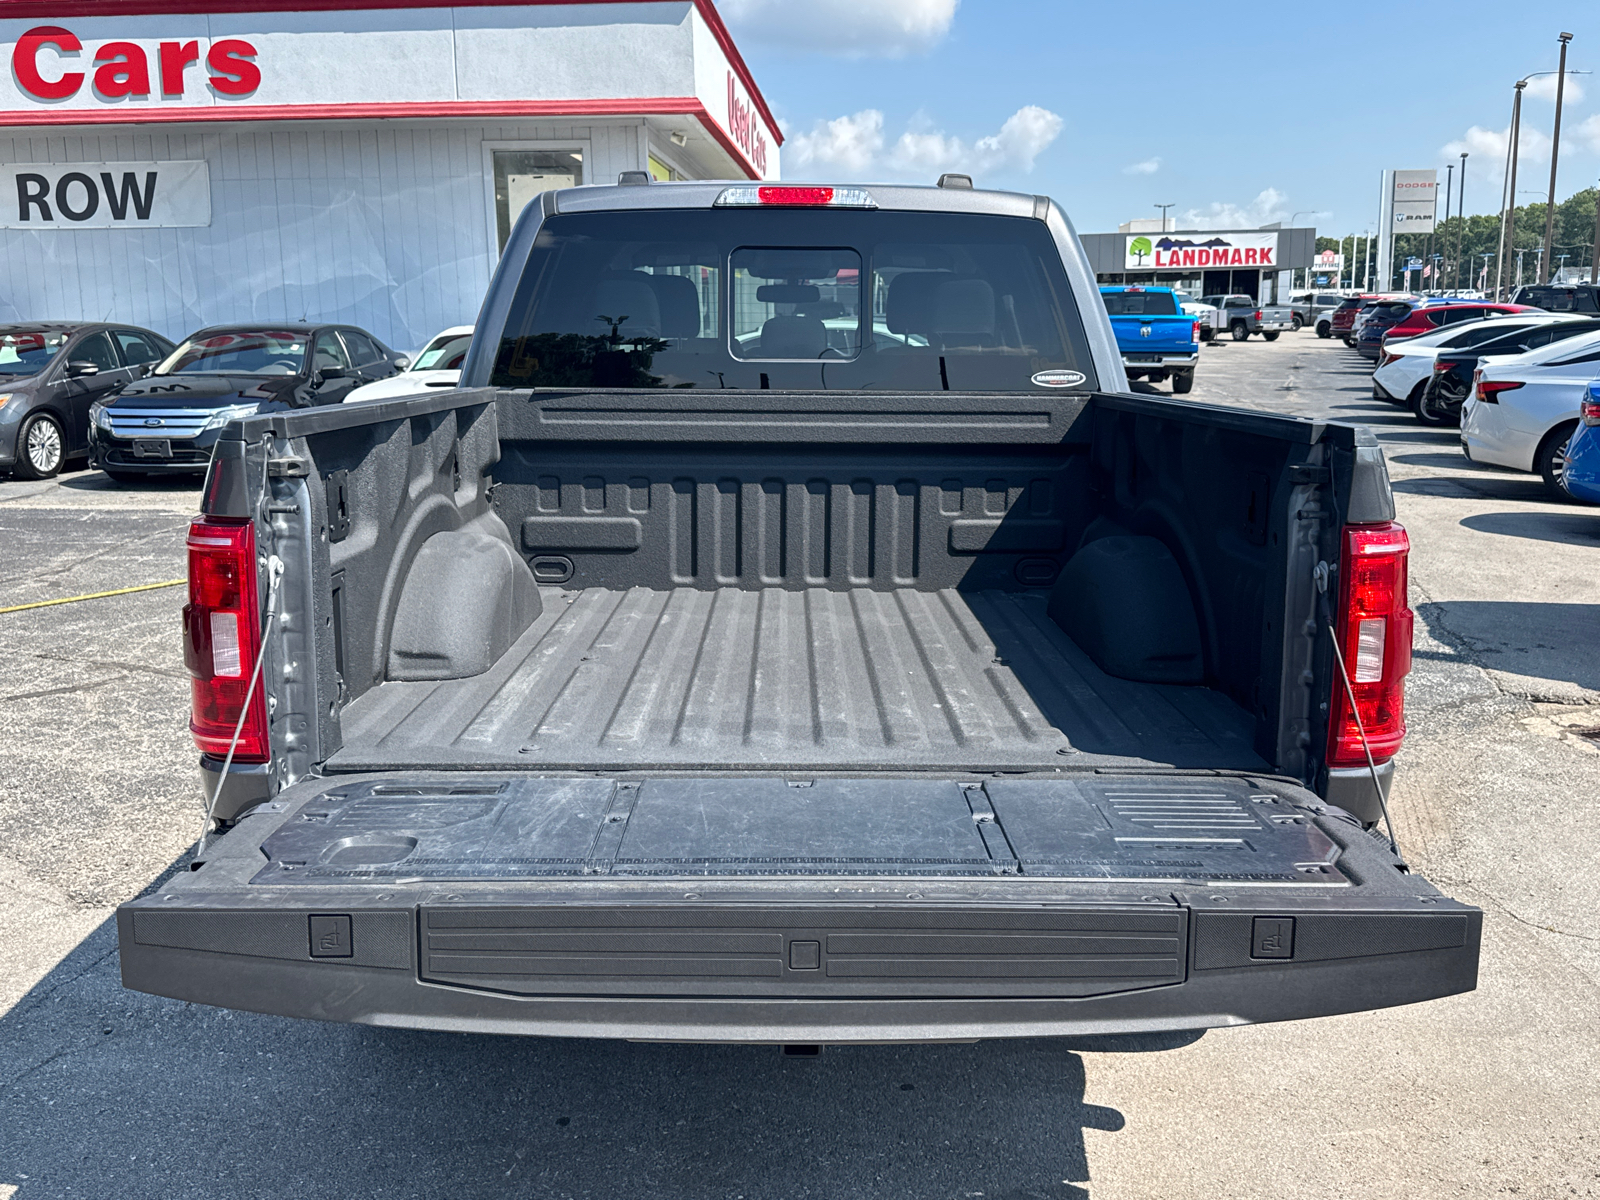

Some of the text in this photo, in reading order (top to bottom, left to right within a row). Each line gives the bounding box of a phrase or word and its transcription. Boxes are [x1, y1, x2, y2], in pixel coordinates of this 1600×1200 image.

[13, 25, 261, 100] Cars
[727, 69, 767, 176] Used Cars
[15, 172, 158, 221] ROW
[1155, 247, 1273, 267] LANDMARK
